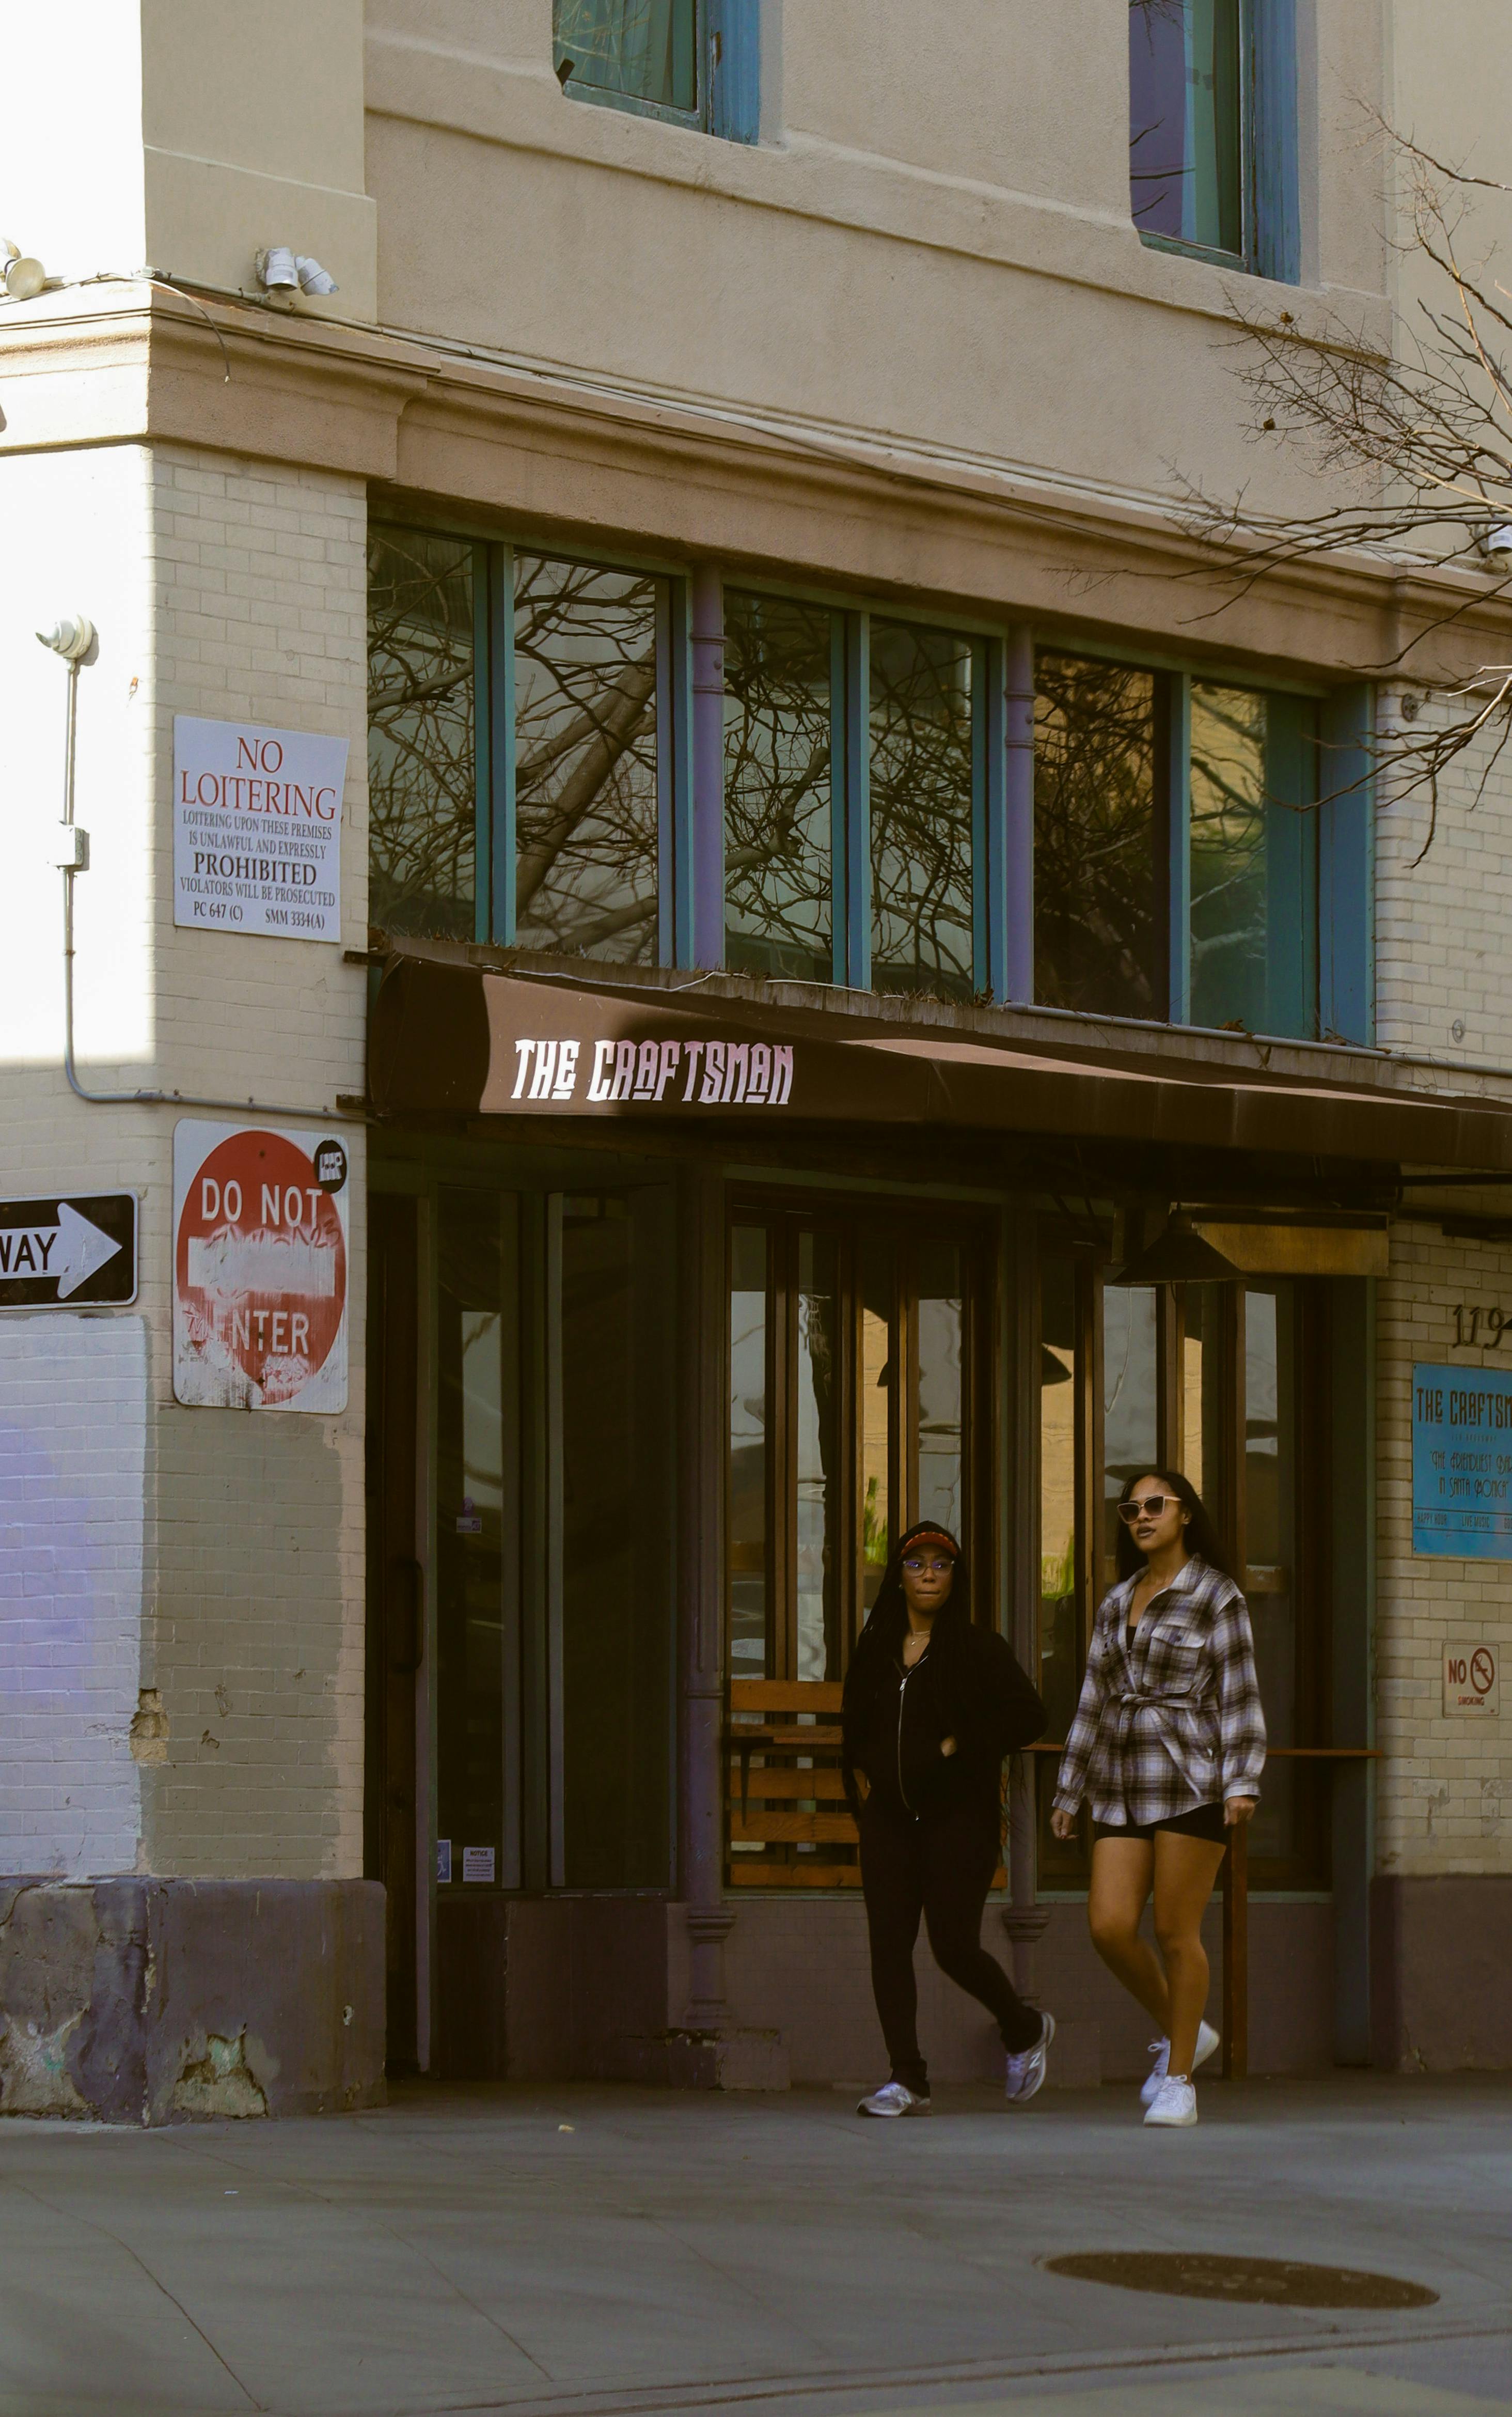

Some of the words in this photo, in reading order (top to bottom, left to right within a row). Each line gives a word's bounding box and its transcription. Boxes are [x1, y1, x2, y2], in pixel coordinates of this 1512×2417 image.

[236, 737, 283, 773] NO
[180, 770, 336, 820] LOITERING
[183, 809, 232, 830] LOITERING
[234, 816, 259, 832] UPON
[259, 819, 290, 836] THESE
[291, 823, 332, 840] PREMISES
[189, 831, 197, 846] IS
[200, 832, 254, 853] UNLAWFUL
[255, 838, 276, 855] AND
[278, 840, 327, 860] EXPRESSLY
[194, 852, 317, 886] PROHIBITED
[180, 877, 232, 897] VIOLATORS
[234, 882, 259, 899] WILL
[261, 885, 274, 901] BE
[275, 887, 336, 907] PROSECUTED
[194, 901, 207, 917] PC
[209, 902, 227, 919] 647
[229, 905, 243, 923] (C)
[264, 908, 288, 926] SMM
[511, 1039, 581, 1100] THE
[585, 1039, 794, 1105] CRAFTSMAN
[201, 1177, 243, 1223] DO
[261, 1183, 323, 1229] NOT
[1452, 1304, 1505, 1350] 119
[1416, 1387, 1443, 1424] THE
[1439, 1476, 1445, 1494] IN
[1450, 1477, 1470, 1498] SANTA
[1418, 1512, 1432, 1524] HAPPY
[1435, 1513, 1447, 1525] HOUR
[1462, 1515, 1473, 1527] LIVE
[1474, 1516, 1490, 1528] MUSIC
[1448, 1659, 1467, 1685] NO
